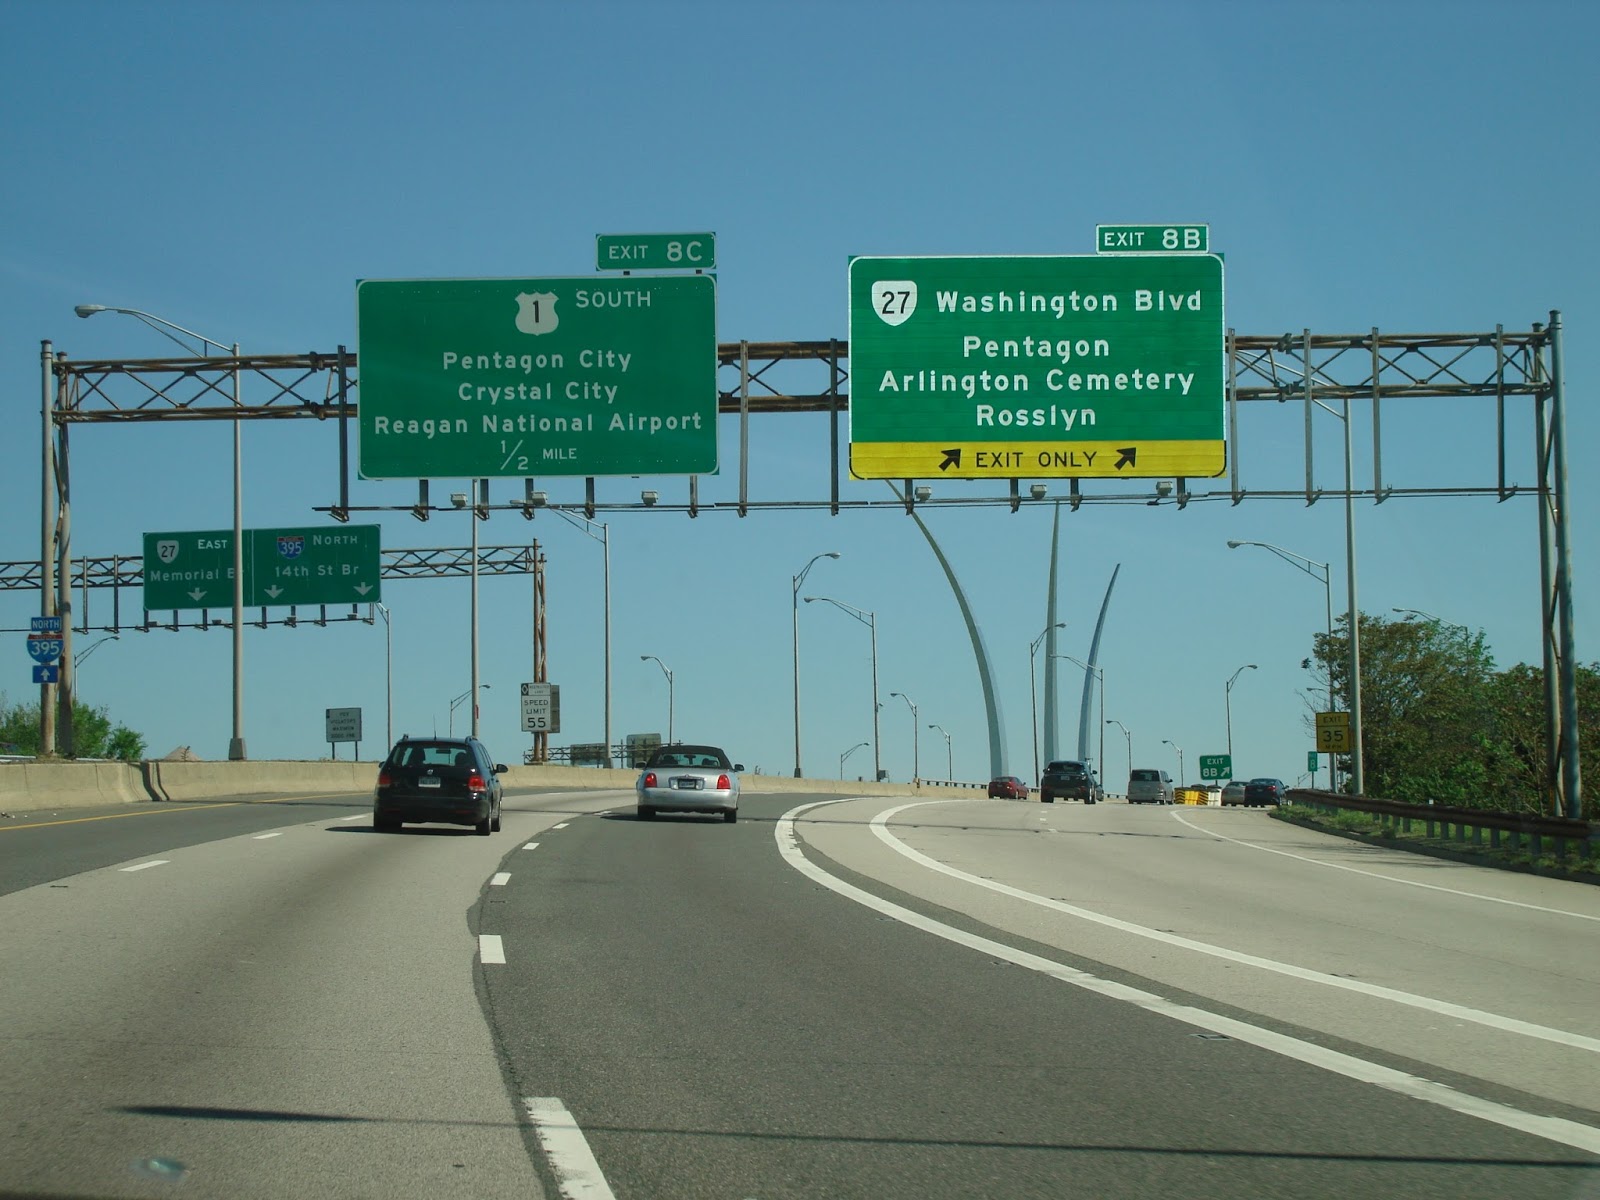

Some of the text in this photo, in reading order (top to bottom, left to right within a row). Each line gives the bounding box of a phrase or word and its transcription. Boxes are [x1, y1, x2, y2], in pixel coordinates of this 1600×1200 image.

[1104, 228, 1201, 250] EXIT 8B
[608, 241, 703, 262] EXIT 8C
[575, 290, 652, 308] SOUTH
[881, 291, 911, 315] 27
[936, 289, 1202, 319] Washington Blvd
[532, 300, 540, 323] 1
[963, 335, 1109, 364] Pentagon
[443, 349, 632, 374] Pentagon City
[879, 368, 1195, 399] Arlington Cemetery
[458, 381, 619, 405] Crystal City
[375, 411, 702, 439] Reagan National Airport
[976, 404, 1096, 431] Rosslyn
[543, 448, 577, 460] MILE
[976, 451, 1098, 468] EXIT ONLY
[197, 539, 228, 550] EAST
[280, 541, 302, 555] 395
[312, 534, 359, 546] NORTH
[161, 545, 176, 558] 27
[150, 567, 219, 582] Memorial
[275, 563, 359, 578] 14th St Br
[32, 619, 60, 629] NORTH
[31, 641, 60, 656] 395
[527, 717, 547, 728] 55
[1322, 730, 1344, 742] 35
[1206, 757, 1224, 765] EXIT
[1202, 767, 1218, 777] 8B
